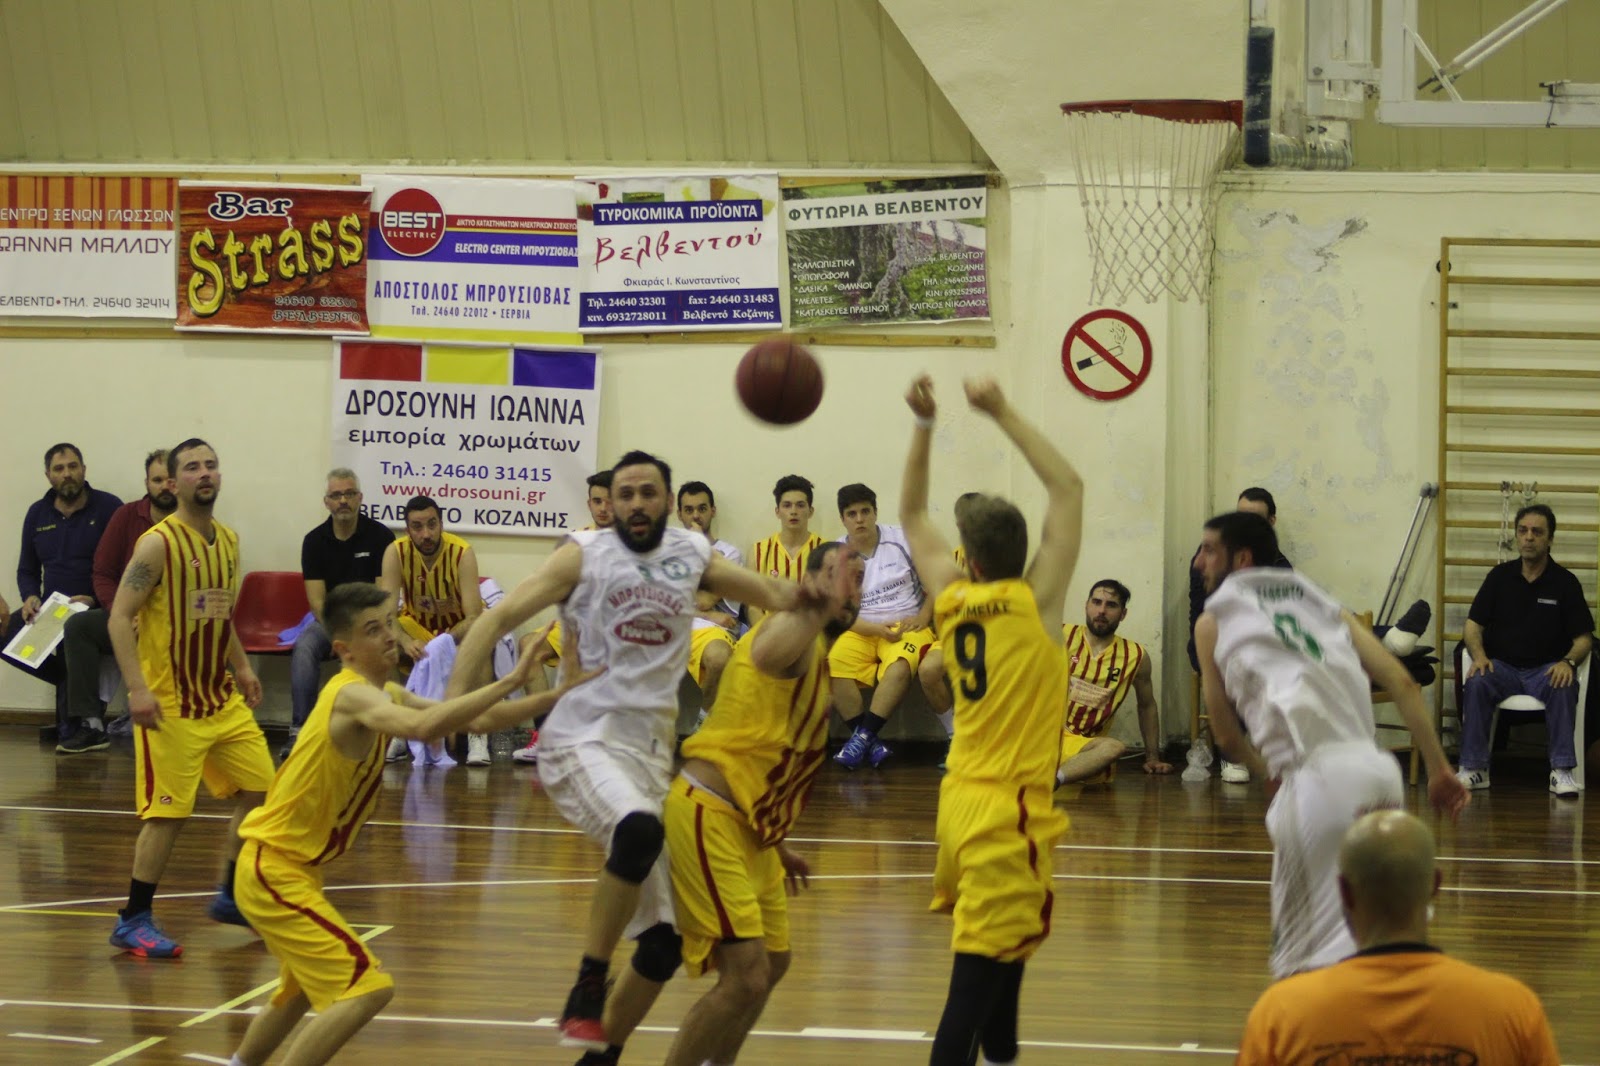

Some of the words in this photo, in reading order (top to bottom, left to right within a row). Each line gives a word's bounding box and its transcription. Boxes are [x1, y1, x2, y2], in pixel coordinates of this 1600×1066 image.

[208, 191, 293, 222] Bar
[598, 206, 684, 222] ΤΥΡΟΚΟΜΙΚΑ
[690, 203, 757, 219] ΠΡΟΪΟΝΤΑ
[789, 204, 868, 221] ΦΥΤΩΡΙΑ
[875, 196, 983, 215] ΒΕΛΒΕΝΤΟΥ
[53, 208, 103, 222] ΞΕΝΩΝ
[108, 209, 174, 222] ΓΛΩΣΣΩΝ
[383, 211, 442, 229] BEST
[387, 230, 437, 239] ELECTRIC
[81, 237, 172, 254] ΜΑΛΛΟΥ
[455, 243, 489, 254] ELECTRO
[490, 244, 520, 255] CENTER
[593, 227, 762, 274] Βελβεντού
[940, 252, 984, 261] ΒΕΛΒΕΝΤΟΥ
[187, 213, 364, 318] Strass
[947, 264, 985, 272] ΚΟΖΑΝΗΣ
[623, 277, 664, 287] Φκιαράς
[675, 275, 740, 286] Κωνσταντίνος
[374, 280, 459, 301] ΑΠΟΣΤΟΛΟΣ
[466, 284, 571, 305] ΜΠΡΟΥΣΙΟΒΑΣ
[688, 295, 708, 305] fax:
[709, 295, 741, 305] 24640
[743, 294, 774, 304] 31483
[93, 297, 131, 308] 24640
[136, 298, 170, 308] 32414
[587, 298, 607, 309] Τηλ.
[608, 298, 638, 307] 24640
[639, 297, 666, 306] 32301
[411, 305, 429, 316] Τηλ.
[434, 306, 460, 317] 24640
[463, 307, 488, 318] 22012
[501, 308, 530, 320] ΣΕΡΒΙΑ
[587, 314, 604, 322] κιν.
[606, 311, 667, 321] 6932728011
[682, 309, 728, 320] Βελβεντό
[732, 308, 774, 320] Κοζάνης
[345, 389, 476, 420] ΔΡΟΣΟΥΝΗ
[490, 395, 585, 425] ΙΩΑΝΝΑ
[348, 426, 446, 448] εμπορία
[459, 431, 581, 453] χρωμάτων
[380, 461, 426, 479] Τηλ.:
[432, 463, 489, 480] 24640
[495, 465, 552, 482] 31415
[382, 483, 546, 505] www.drosouni.gr
[360, 504, 462, 524] ΒΕΛΒΤΟ
[474, 508, 568, 529] ΚΟΖΑΝΗΣ
[902, 642, 916, 654] 15
[954, 621, 988, 701] 9
[1107, 667, 1121, 682] 12
